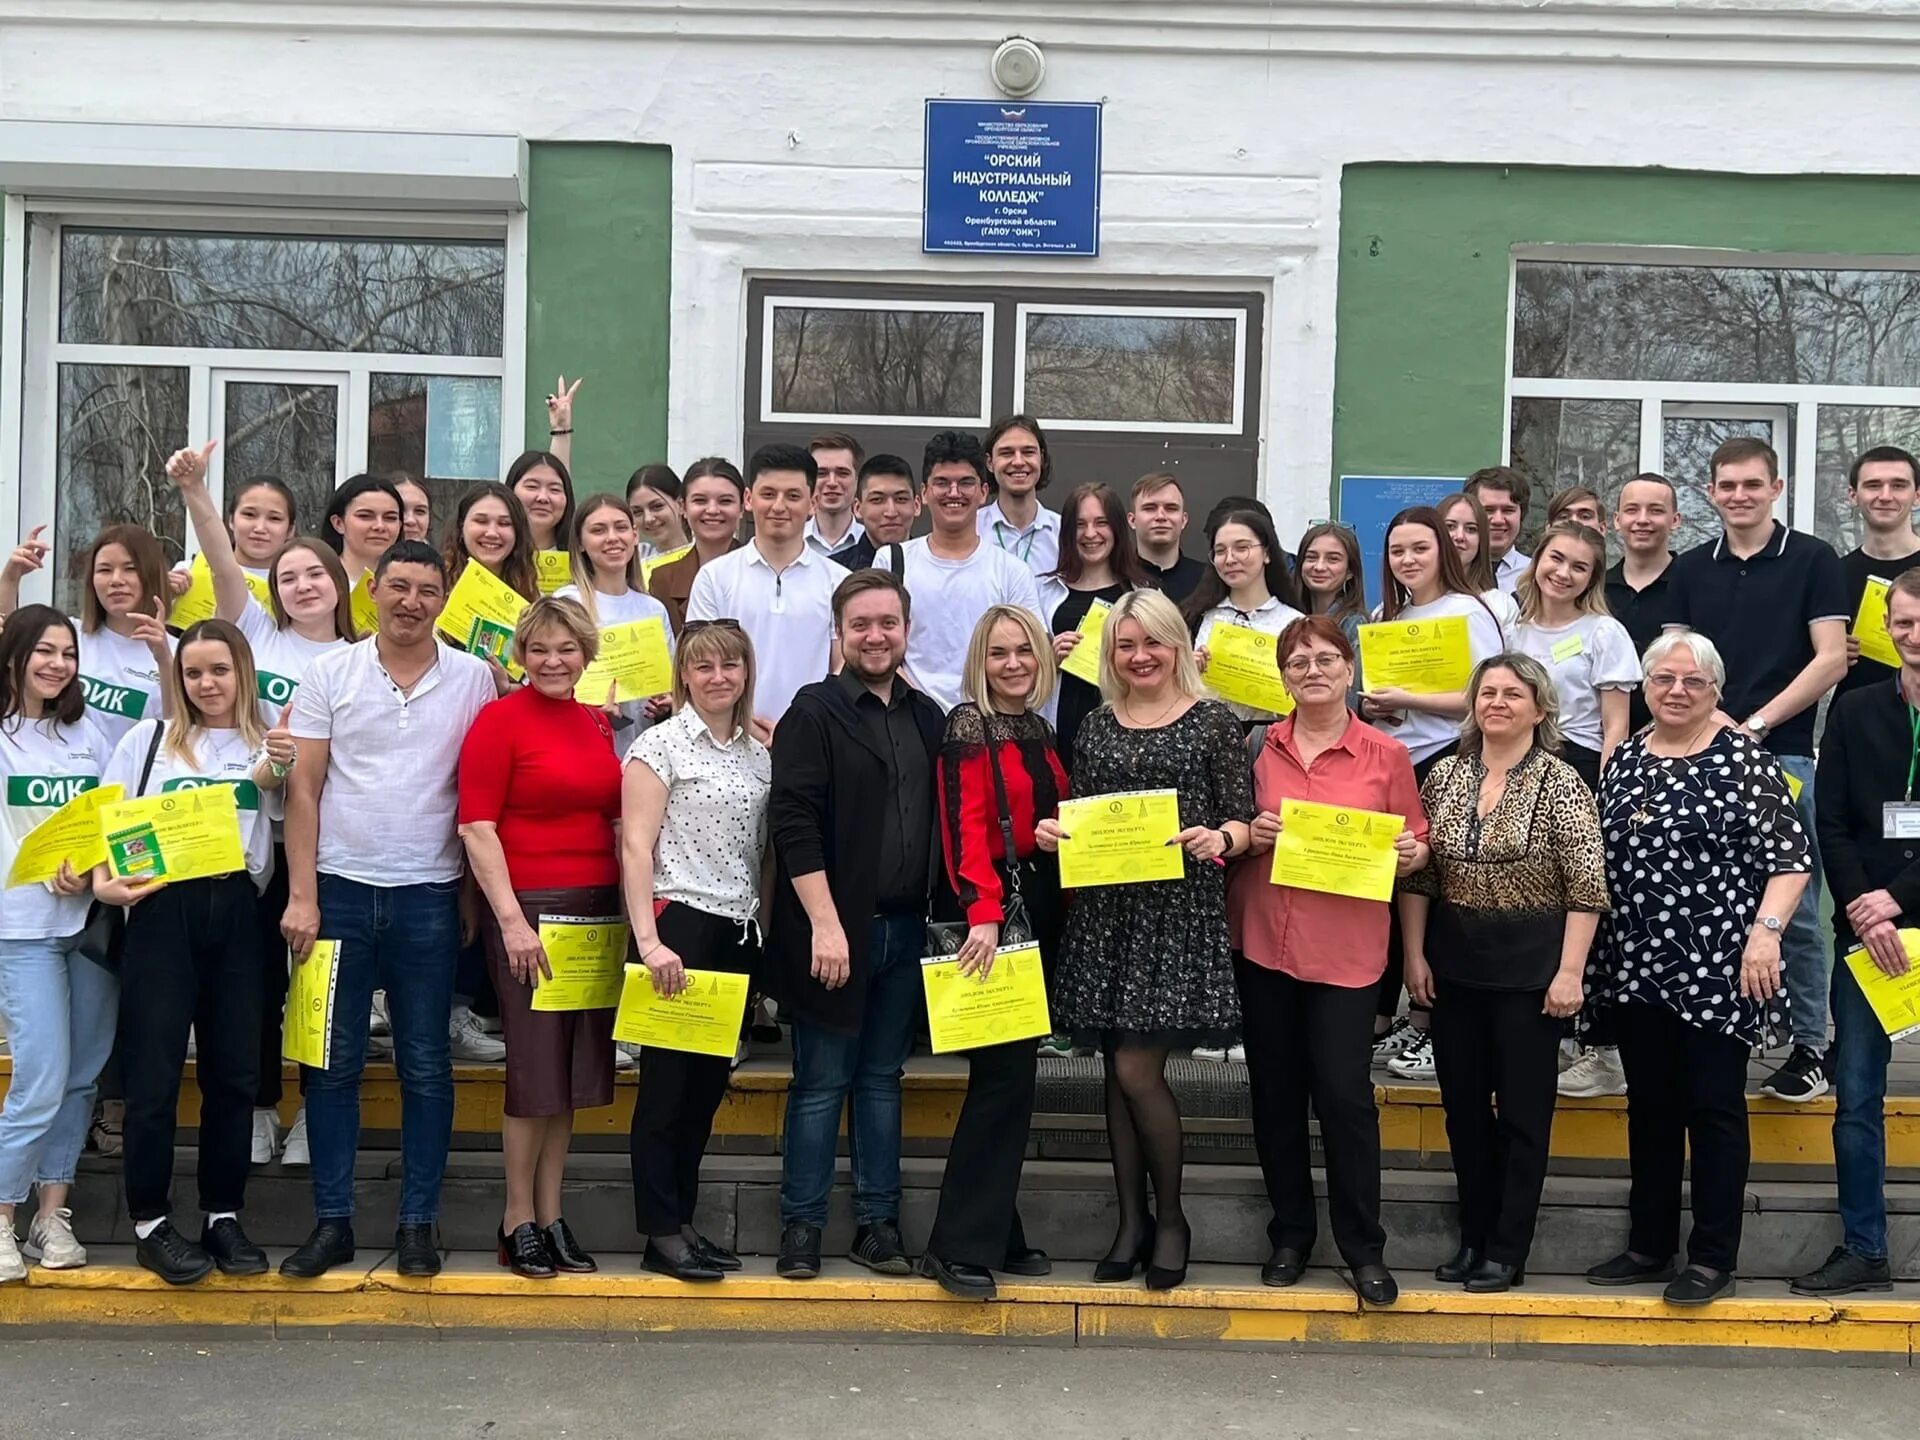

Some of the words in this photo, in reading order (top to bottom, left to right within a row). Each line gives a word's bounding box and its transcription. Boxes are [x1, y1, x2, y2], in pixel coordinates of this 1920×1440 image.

[952, 171, 1072, 186] ИНДУСТРИАЛЬНЫЙ
[1002, 206, 1028, 216] Орска
[964, 216, 1022, 227] Оренбургской
[1023, 218, 1057, 226] области
[981, 227, 1010, 237] (ГАПОУ
